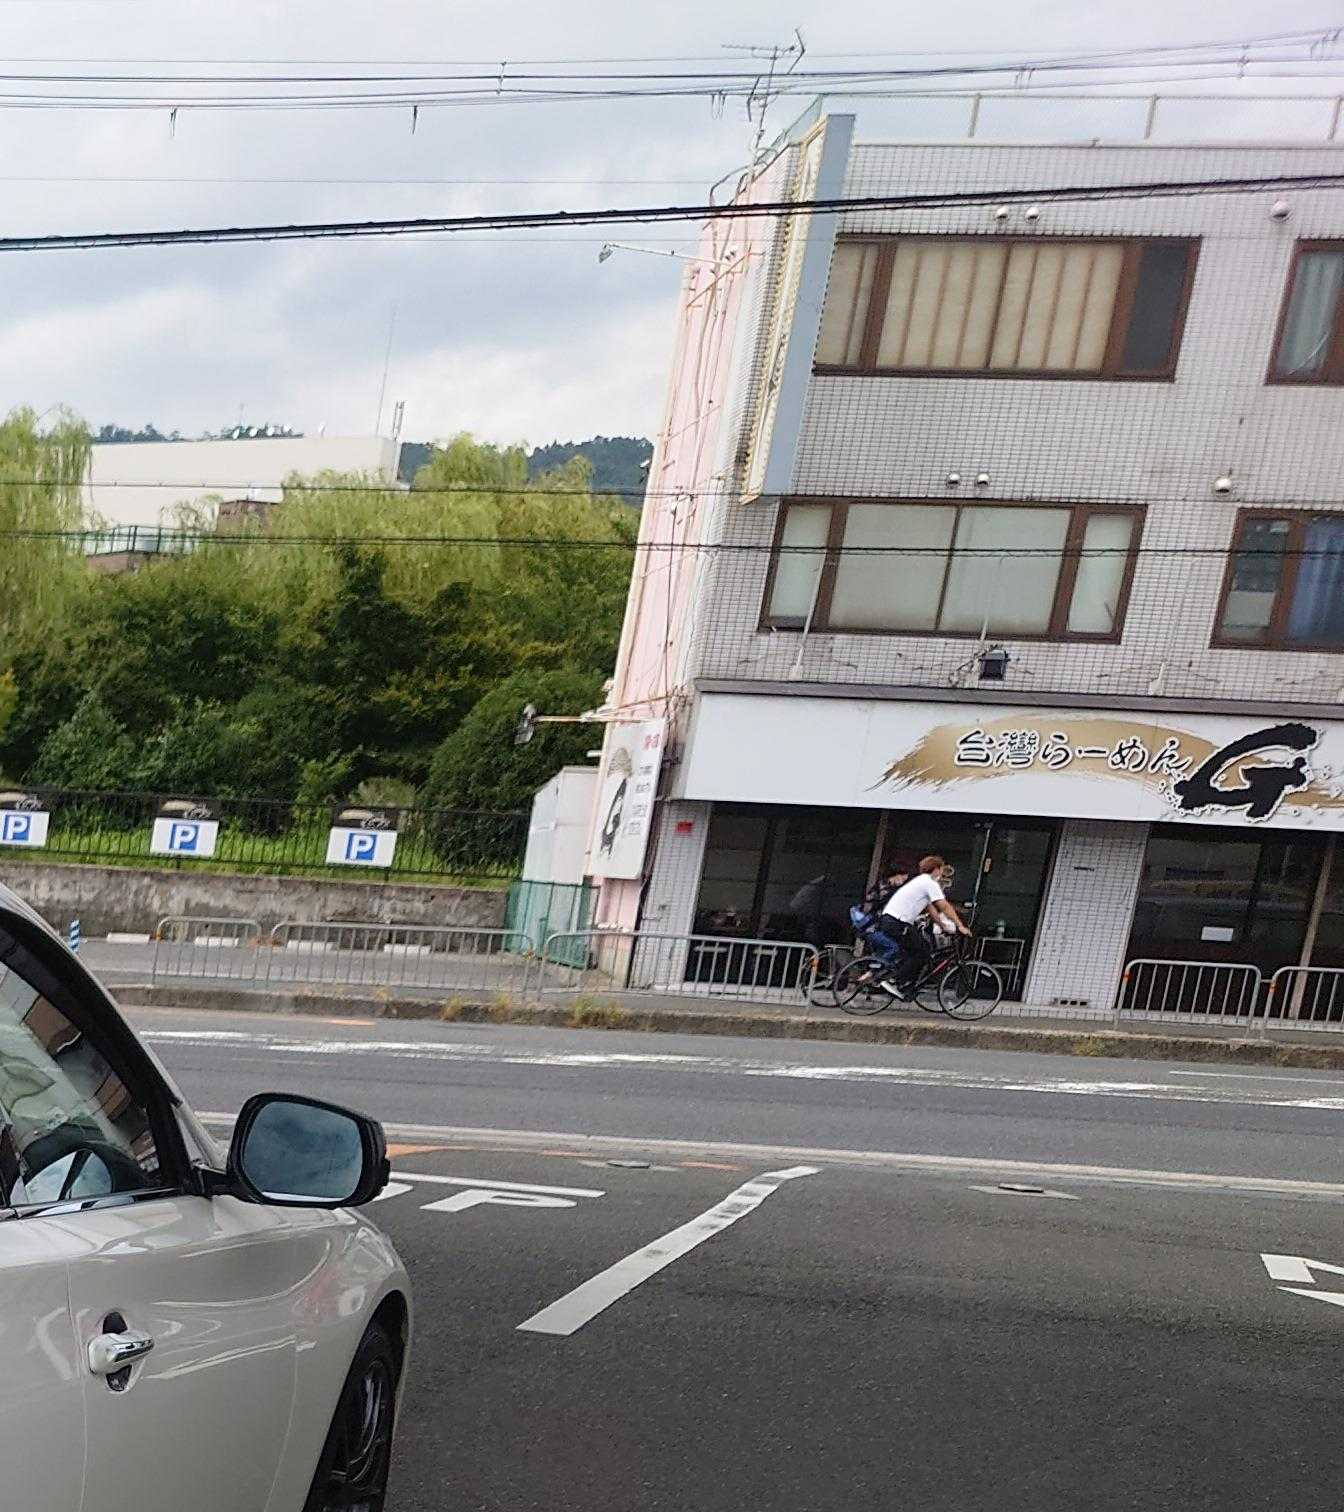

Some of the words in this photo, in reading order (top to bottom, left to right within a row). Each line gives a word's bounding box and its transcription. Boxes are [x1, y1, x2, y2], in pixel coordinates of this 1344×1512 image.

[6, 815, 29, 840] P
[174, 825, 197, 850] P
[349, 835, 374, 861] P
